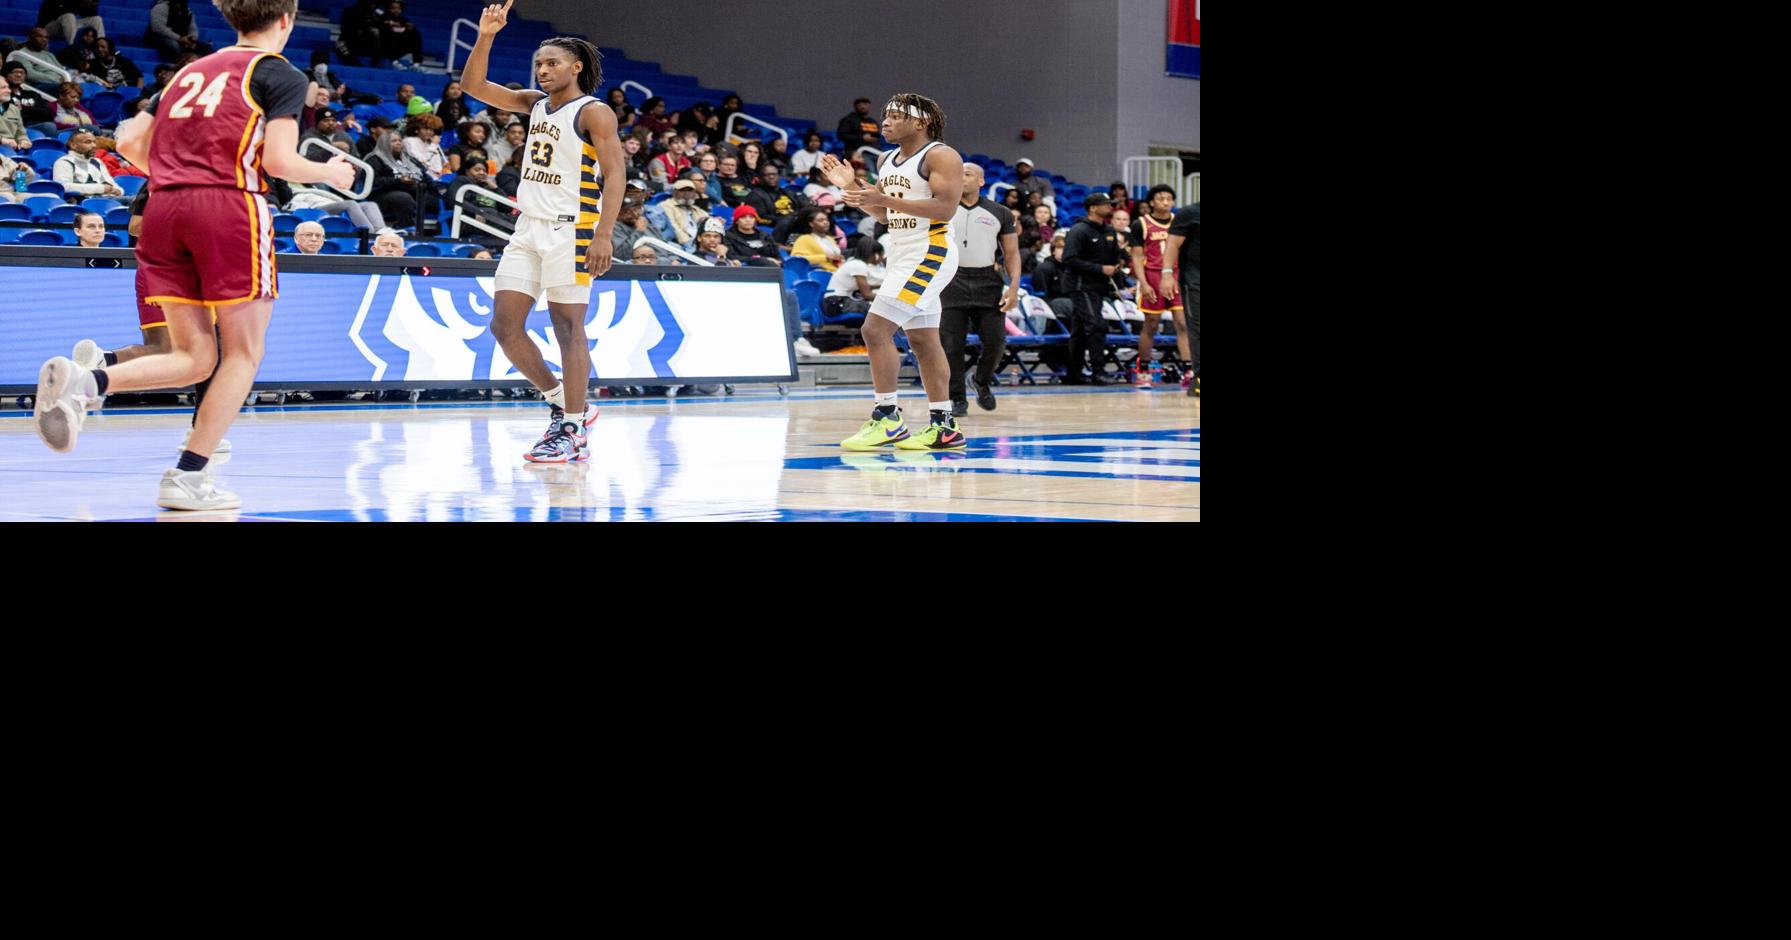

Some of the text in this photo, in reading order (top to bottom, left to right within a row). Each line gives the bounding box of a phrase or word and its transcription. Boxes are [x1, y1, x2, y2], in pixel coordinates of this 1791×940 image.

[169, 72, 231, 119] 24
[530, 140, 554, 168] 23
[880, 174, 911, 190] AGLES
